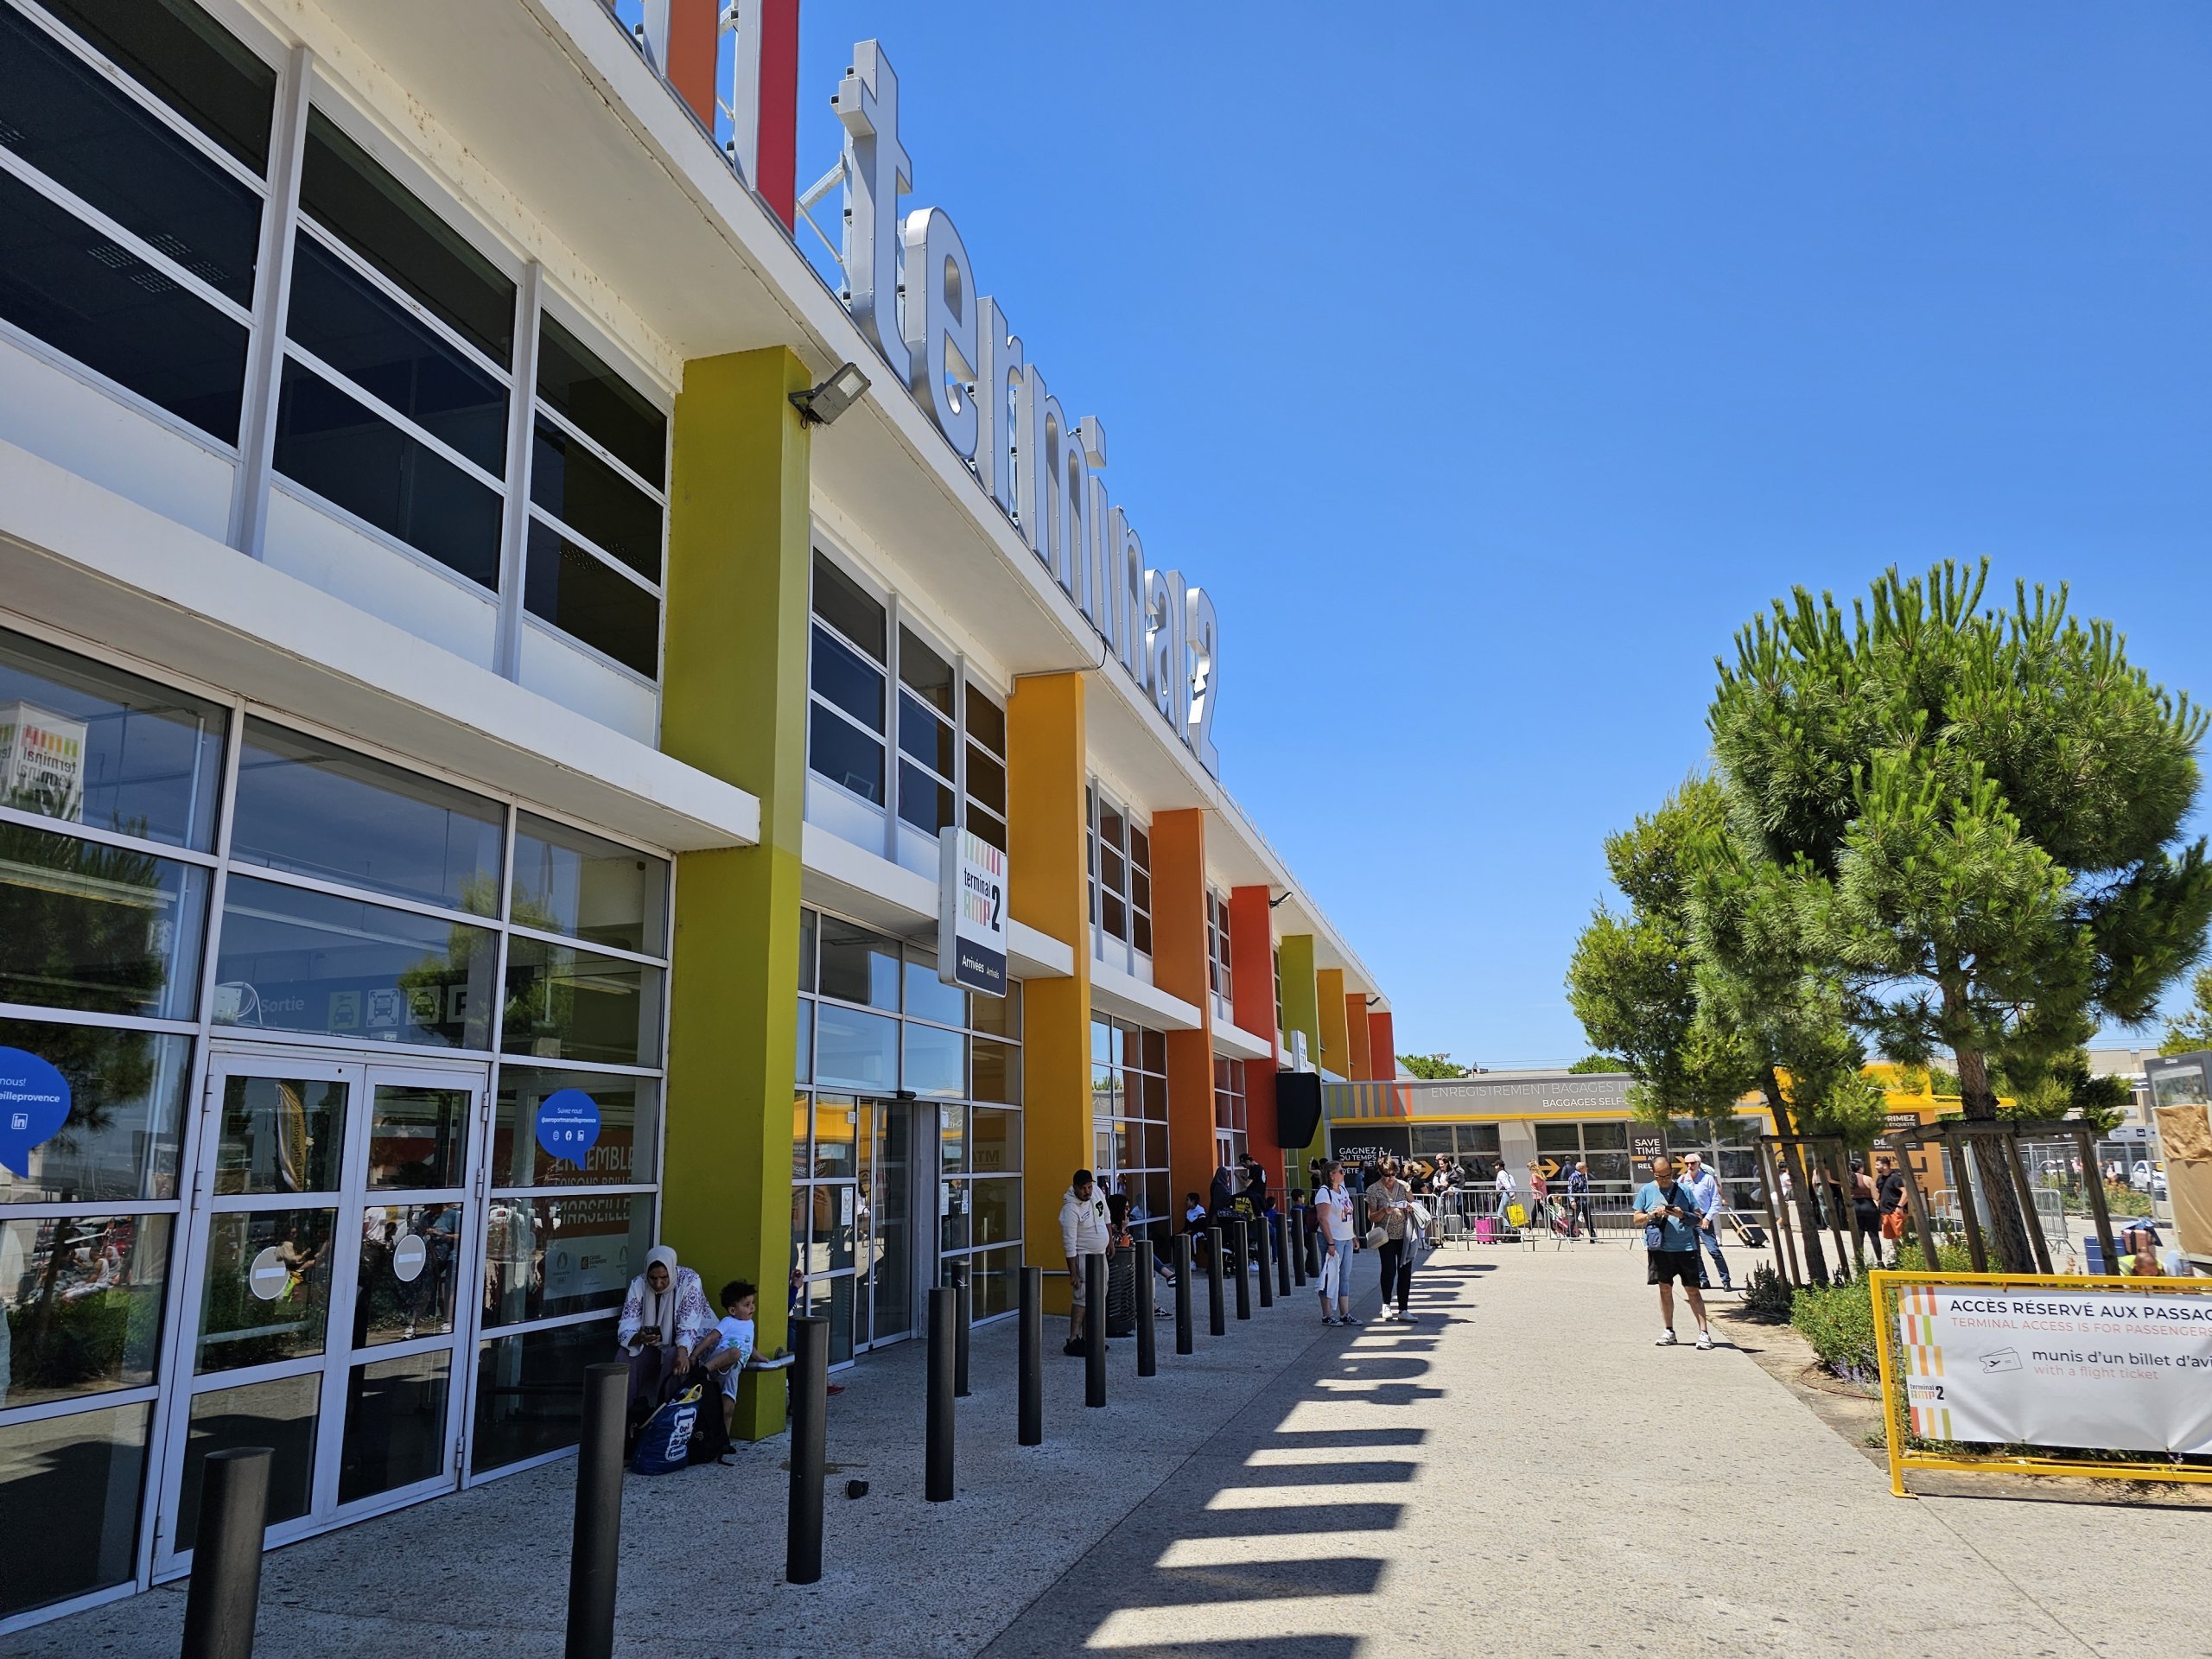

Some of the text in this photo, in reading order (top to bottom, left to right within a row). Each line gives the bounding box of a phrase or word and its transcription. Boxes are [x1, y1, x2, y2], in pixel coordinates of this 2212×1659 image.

[833, 38, 1219, 781] terminal 2
[963, 867, 1001, 932] terminal 2
[962, 955, 984, 973] Arrivées
[260, 996, 304, 1013] Sortie
[0, 1077, 27, 1087] nous!
[1431, 1084, 1547, 1097] ENREGISTREMENT
[1551, 1081, 1613, 1094] BAGAGES
[0, 1091, 60, 1103] eilleprovence
[1542, 1096, 1629, 1108] BAGGAGES SELF-
[1634, 1138, 1661, 1147] SAVE
[1635, 1147, 1662, 1155] TIME
[1950, 1299, 2007, 1313] ACCÈS
[2013, 1300, 2094, 1317] RÉSERVÉ
[2101, 1306, 2138, 1319] AUX
[1950, 1317, 2212, 1337] TERMINAL ACCESS IS FOR PASSENGERS
[2032, 1351, 2083, 1362] munis
[2129, 1352, 2171, 1366] billet
[2033, 1365, 2063, 1376] with
[2080, 1366, 2116, 1379] flight
[2120, 1368, 2158, 1380] ticket
[1936, 1385, 1944, 1400] 2
